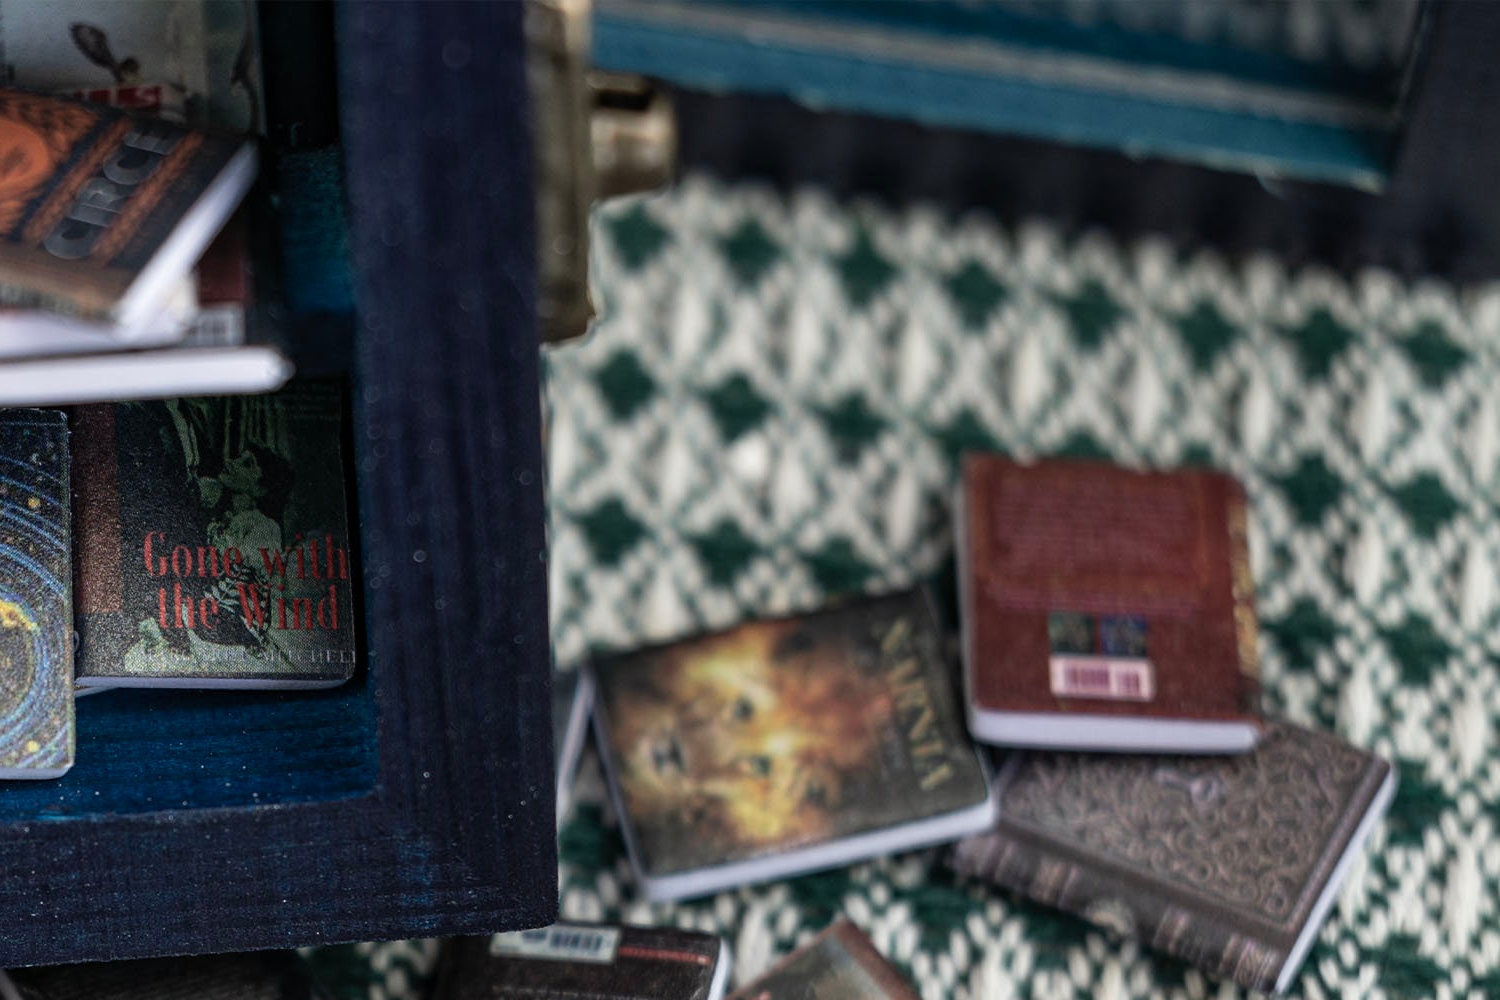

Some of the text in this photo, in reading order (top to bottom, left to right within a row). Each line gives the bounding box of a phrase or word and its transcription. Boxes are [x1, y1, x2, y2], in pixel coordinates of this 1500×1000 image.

[44, 124, 189, 260] CIRCE
[144, 531, 348, 581] Gone with
[158, 582, 339, 633] the Wind
